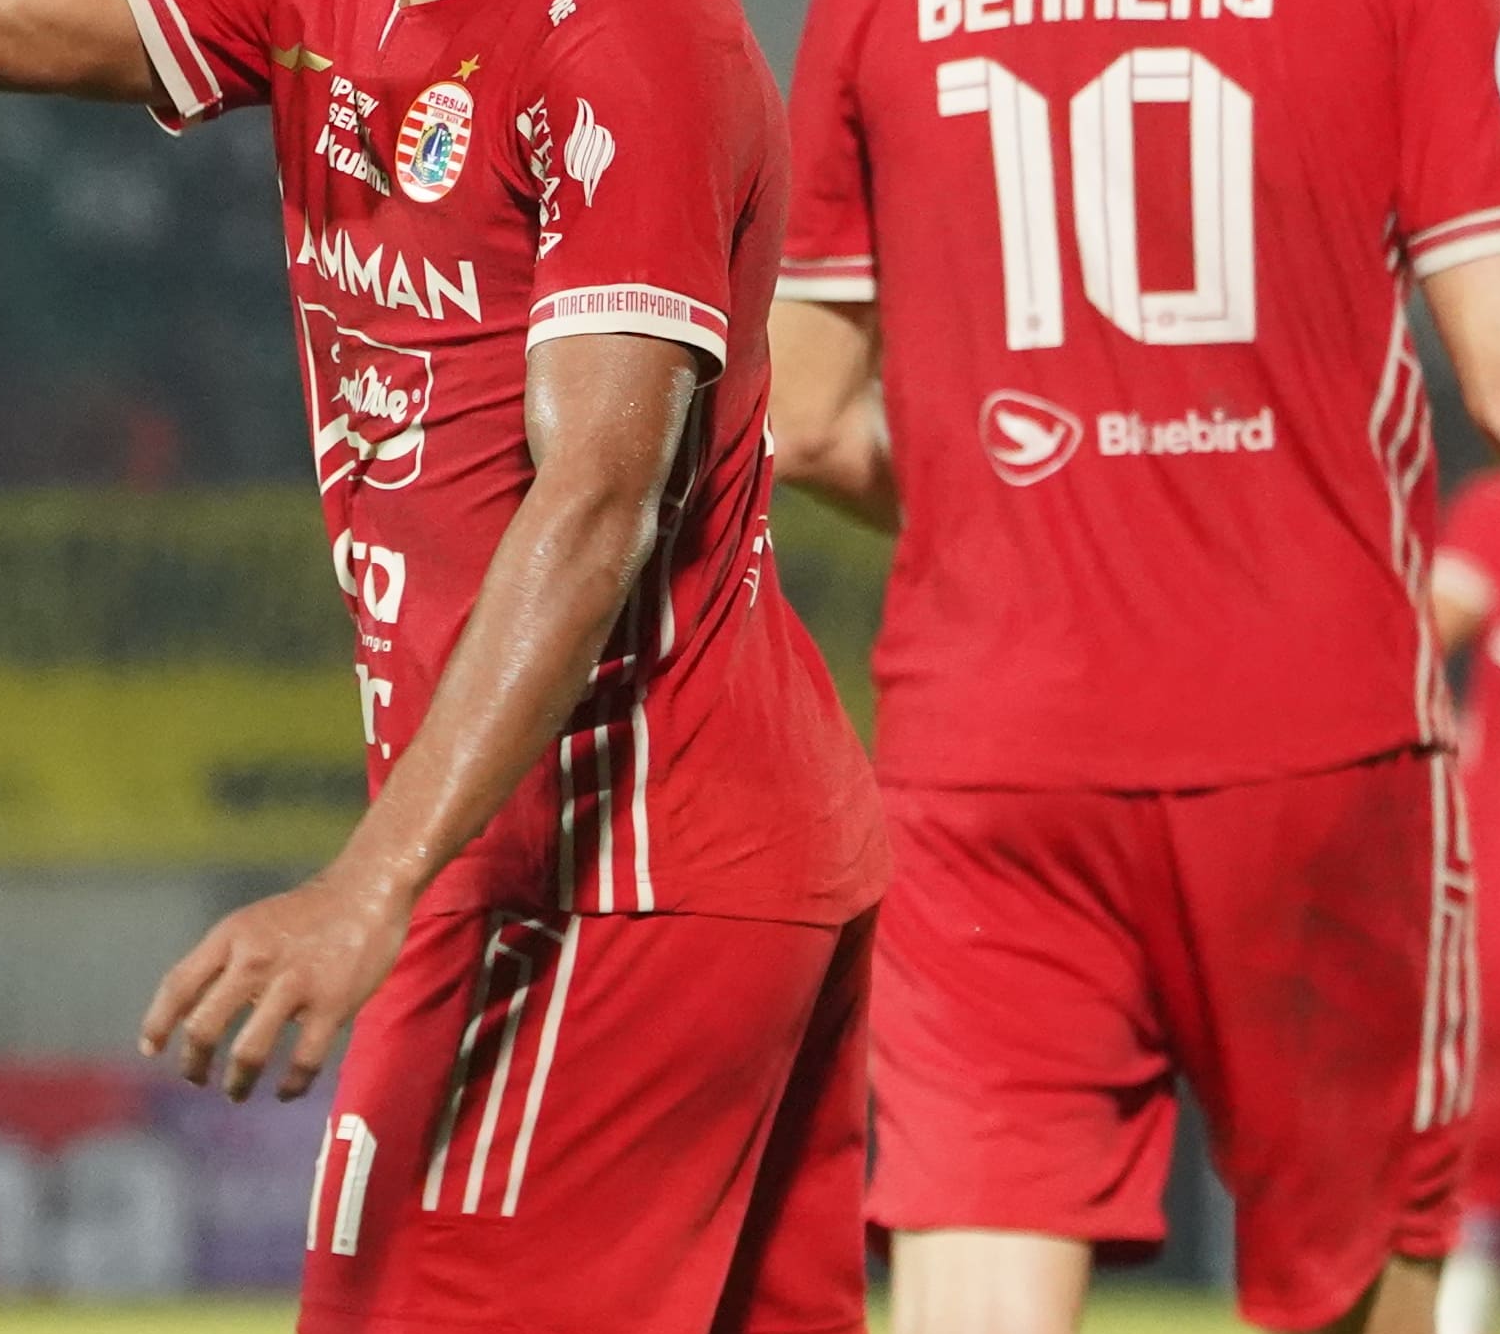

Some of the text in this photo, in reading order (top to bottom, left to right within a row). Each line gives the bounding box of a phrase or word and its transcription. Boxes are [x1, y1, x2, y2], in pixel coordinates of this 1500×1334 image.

[428, 90, 469, 115] PERSIJA
[936, 46, 1257, 352] 10
[296, 215, 483, 324] AMMAN
[1097, 407, 1276, 457] Bluebird
